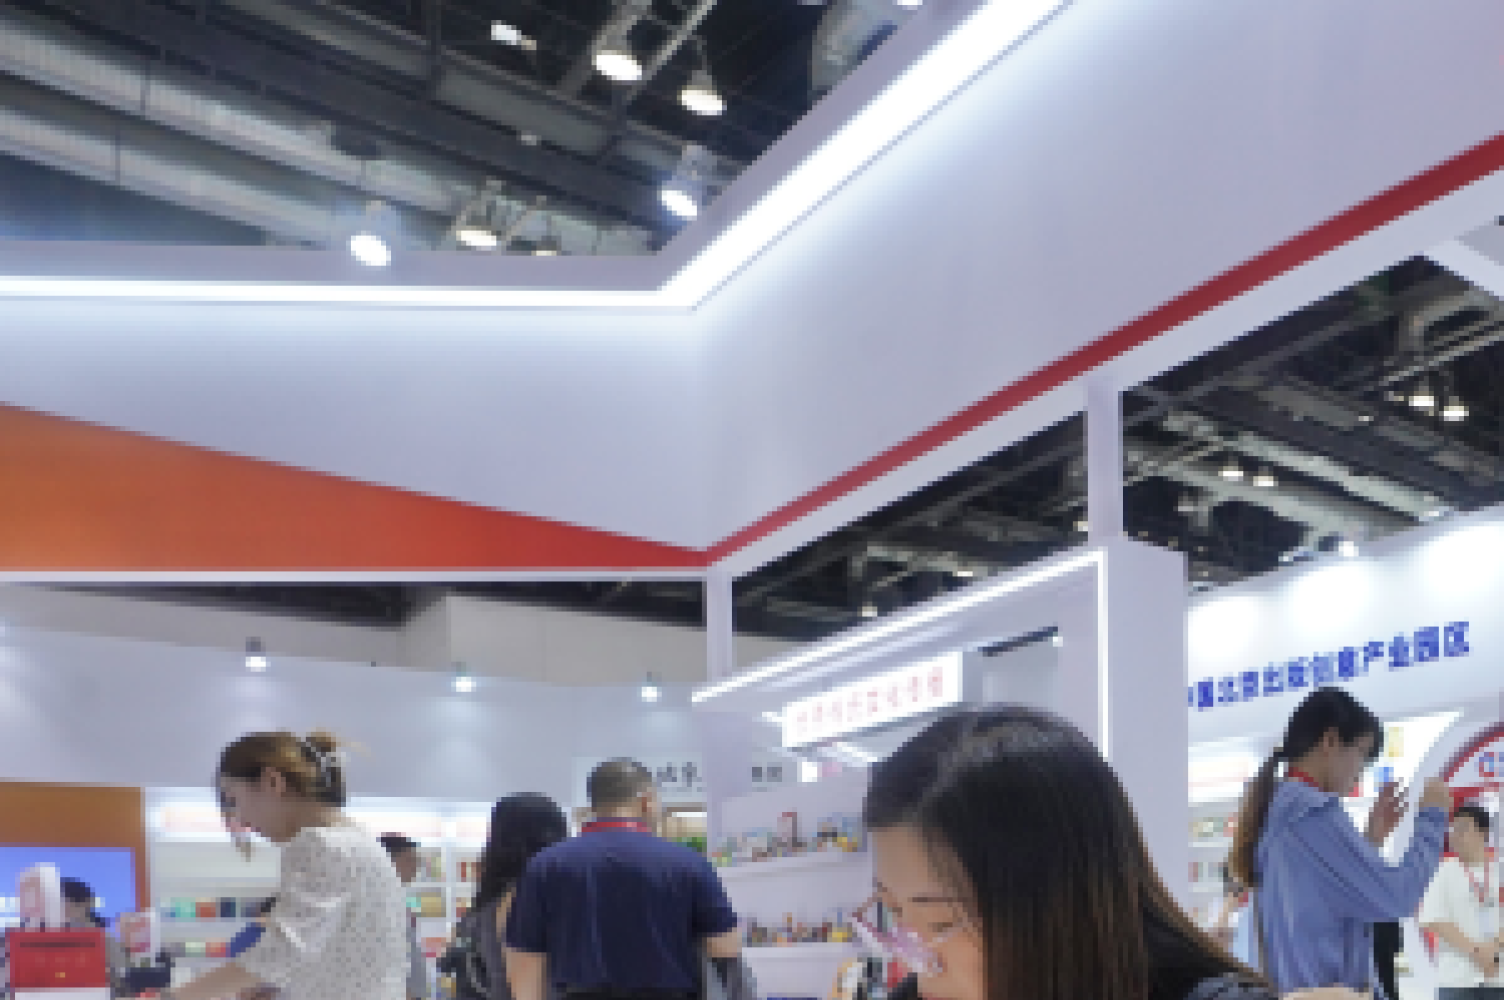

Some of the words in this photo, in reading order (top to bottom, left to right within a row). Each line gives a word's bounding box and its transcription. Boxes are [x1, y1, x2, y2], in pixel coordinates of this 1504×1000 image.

[1187, 620, 1470, 711] 国北京出版创意产业园区
